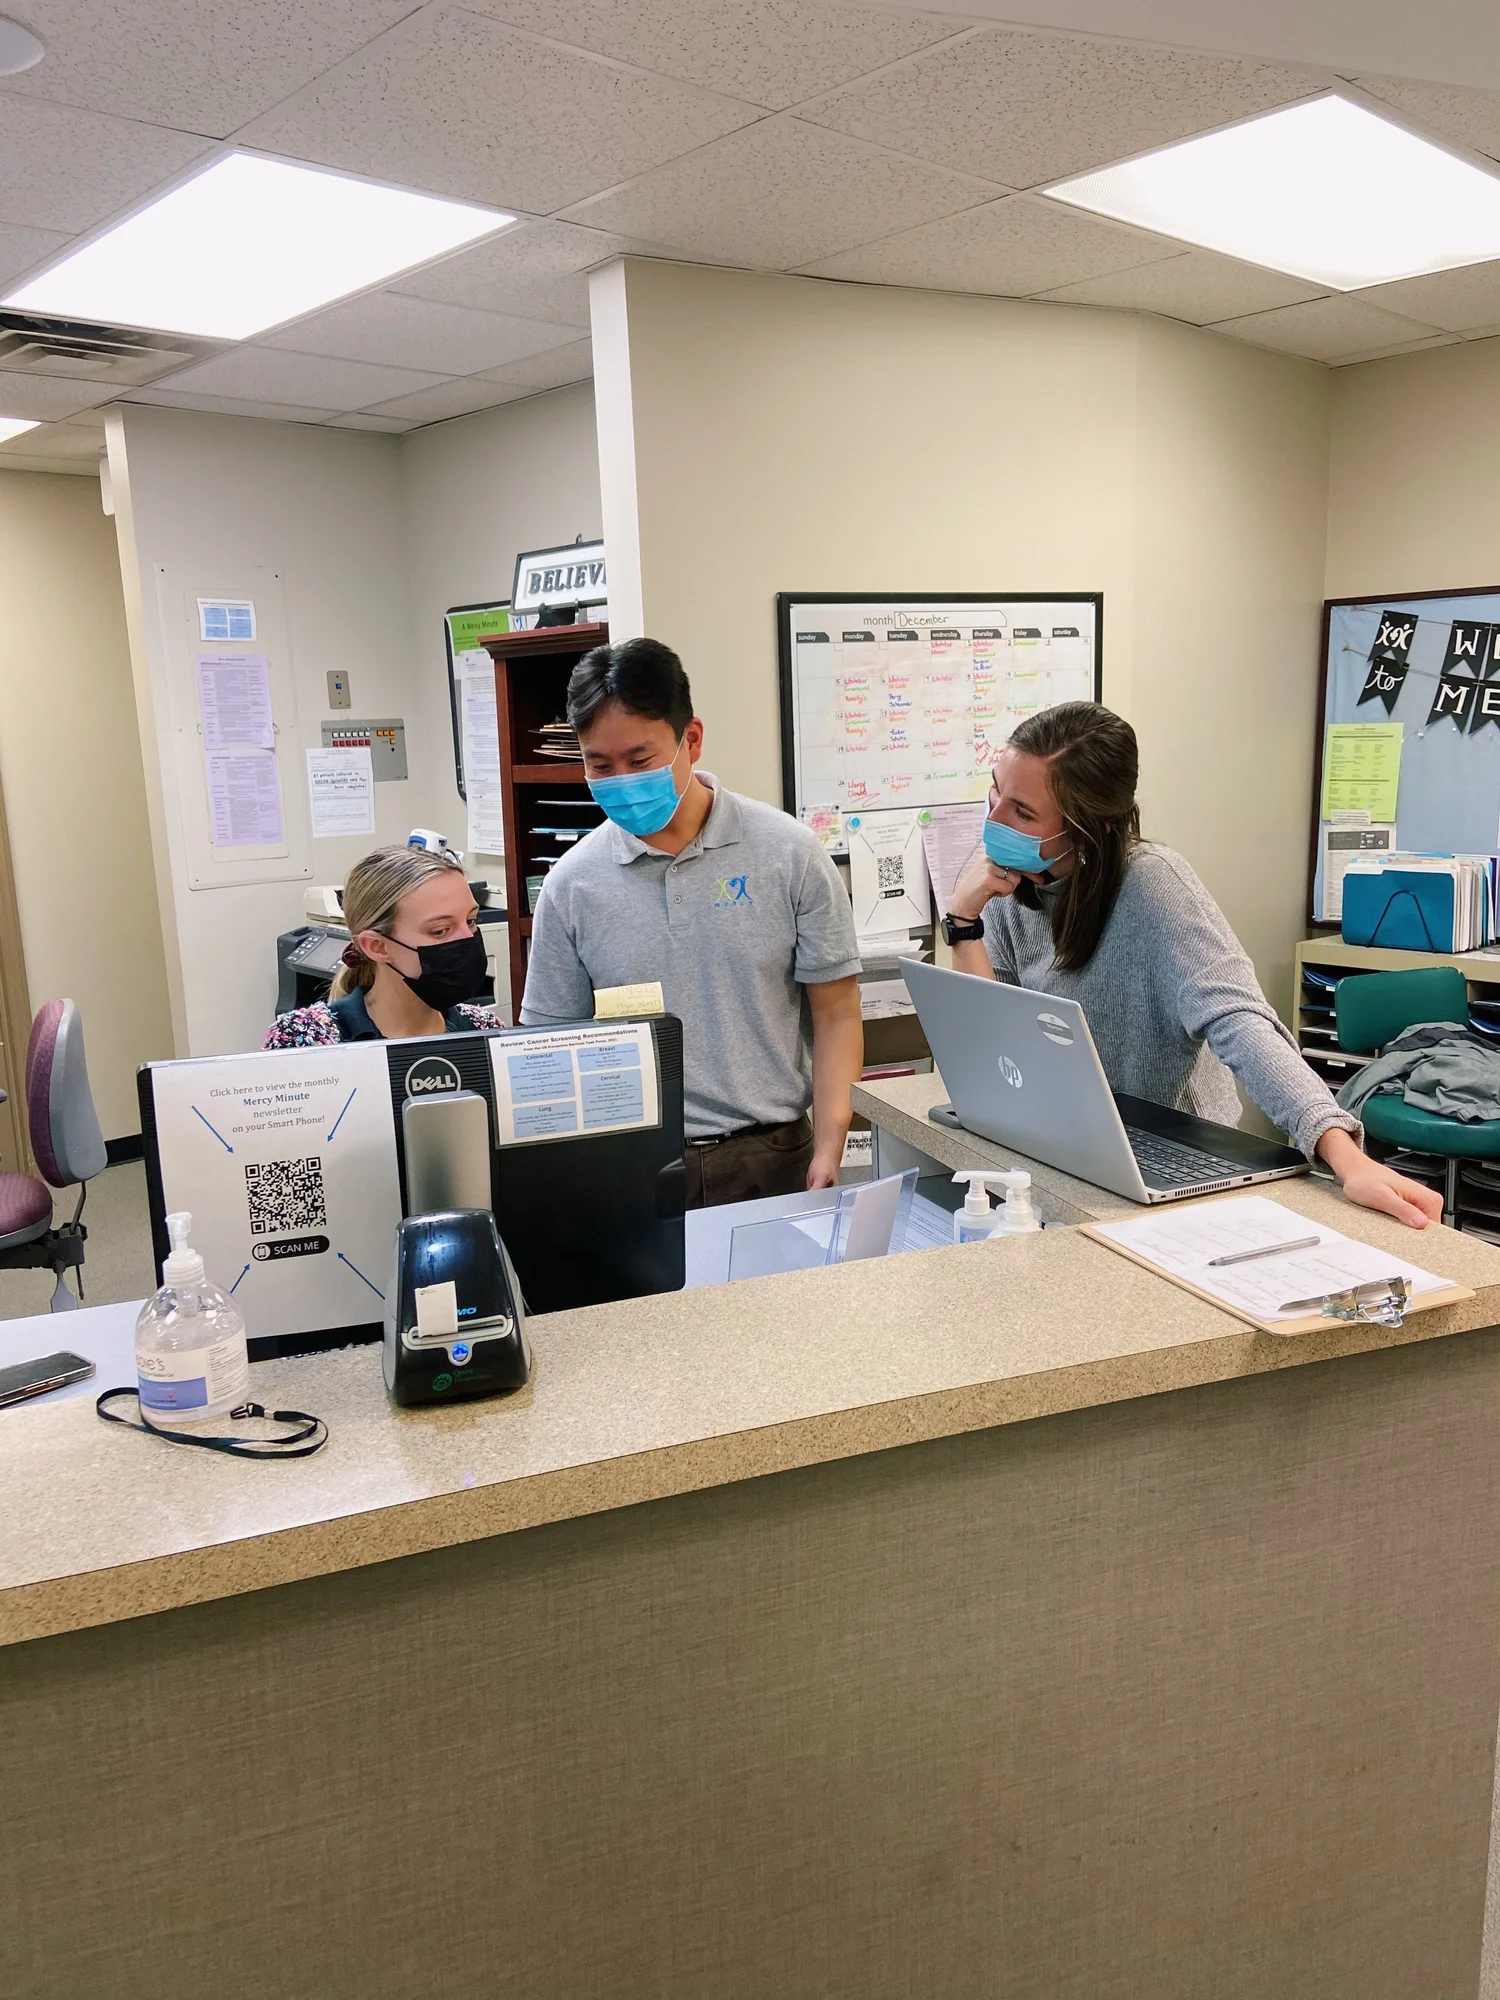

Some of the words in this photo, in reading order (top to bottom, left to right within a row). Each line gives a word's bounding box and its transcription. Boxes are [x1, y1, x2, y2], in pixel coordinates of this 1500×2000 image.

[528, 562, 606, 594] BELIEV
[863, 615, 893, 626] month
[897, 612, 949, 627] December
[798, 633, 816, 641] sunday
[1453, 629, 1500, 659] W
[1365, 665, 1404, 691] to
[550, 1034, 582, 1042] Screening
[582, 1028, 638, 1039] Recommendations
[210, 1088, 232, 1098] Click
[233, 1086, 253, 1094] here
[255, 1084, 264, 1092] to
[288, 1080, 302, 1088] the
[304, 1076, 340, 1087] monthly
[412, 1074, 456, 1092] DELL
[243, 1096, 273, 1106] Mercy
[275, 1092, 310, 1102] Minute
[253, 1105, 303, 1118] newsletter
[245, 1123, 266, 1134] your
[267, 1120, 294, 1129] Smart
[296, 1115, 326, 1126] Phone!
[274, 1244, 302, 1254] SCAN
[304, 1240, 320, 1250] ME
